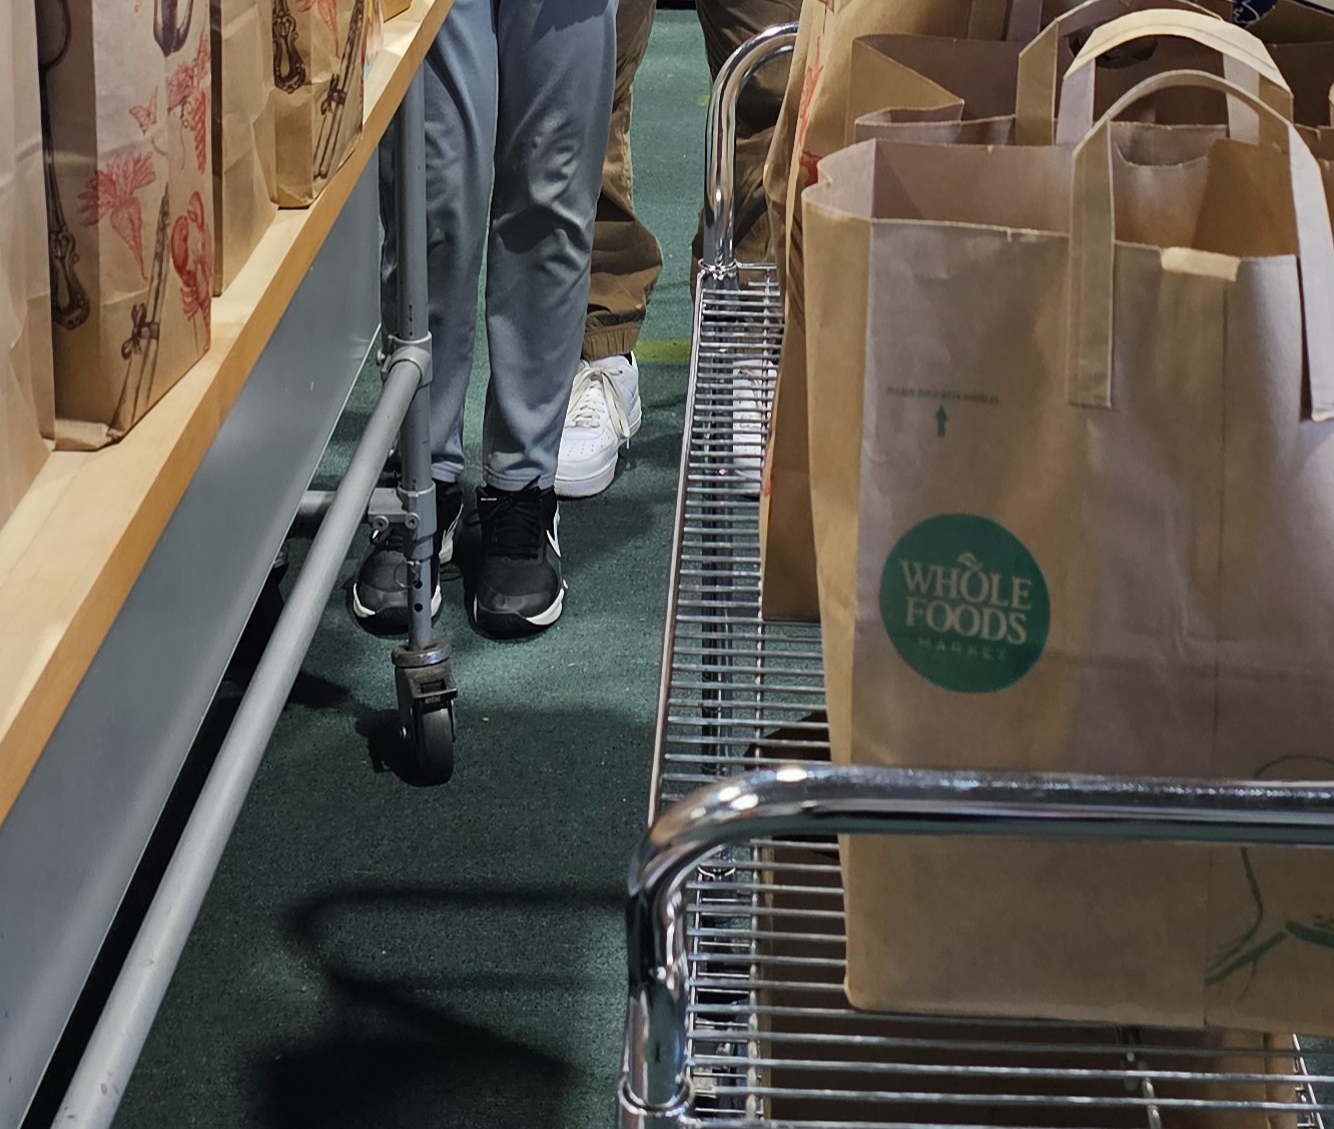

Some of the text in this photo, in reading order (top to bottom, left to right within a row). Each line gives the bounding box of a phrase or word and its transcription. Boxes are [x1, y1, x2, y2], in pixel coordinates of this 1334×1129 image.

[899, 556, 1033, 611] WHOLE
[905, 596, 1027, 645] FOODS
[918, 637, 1008, 661] MARKET
